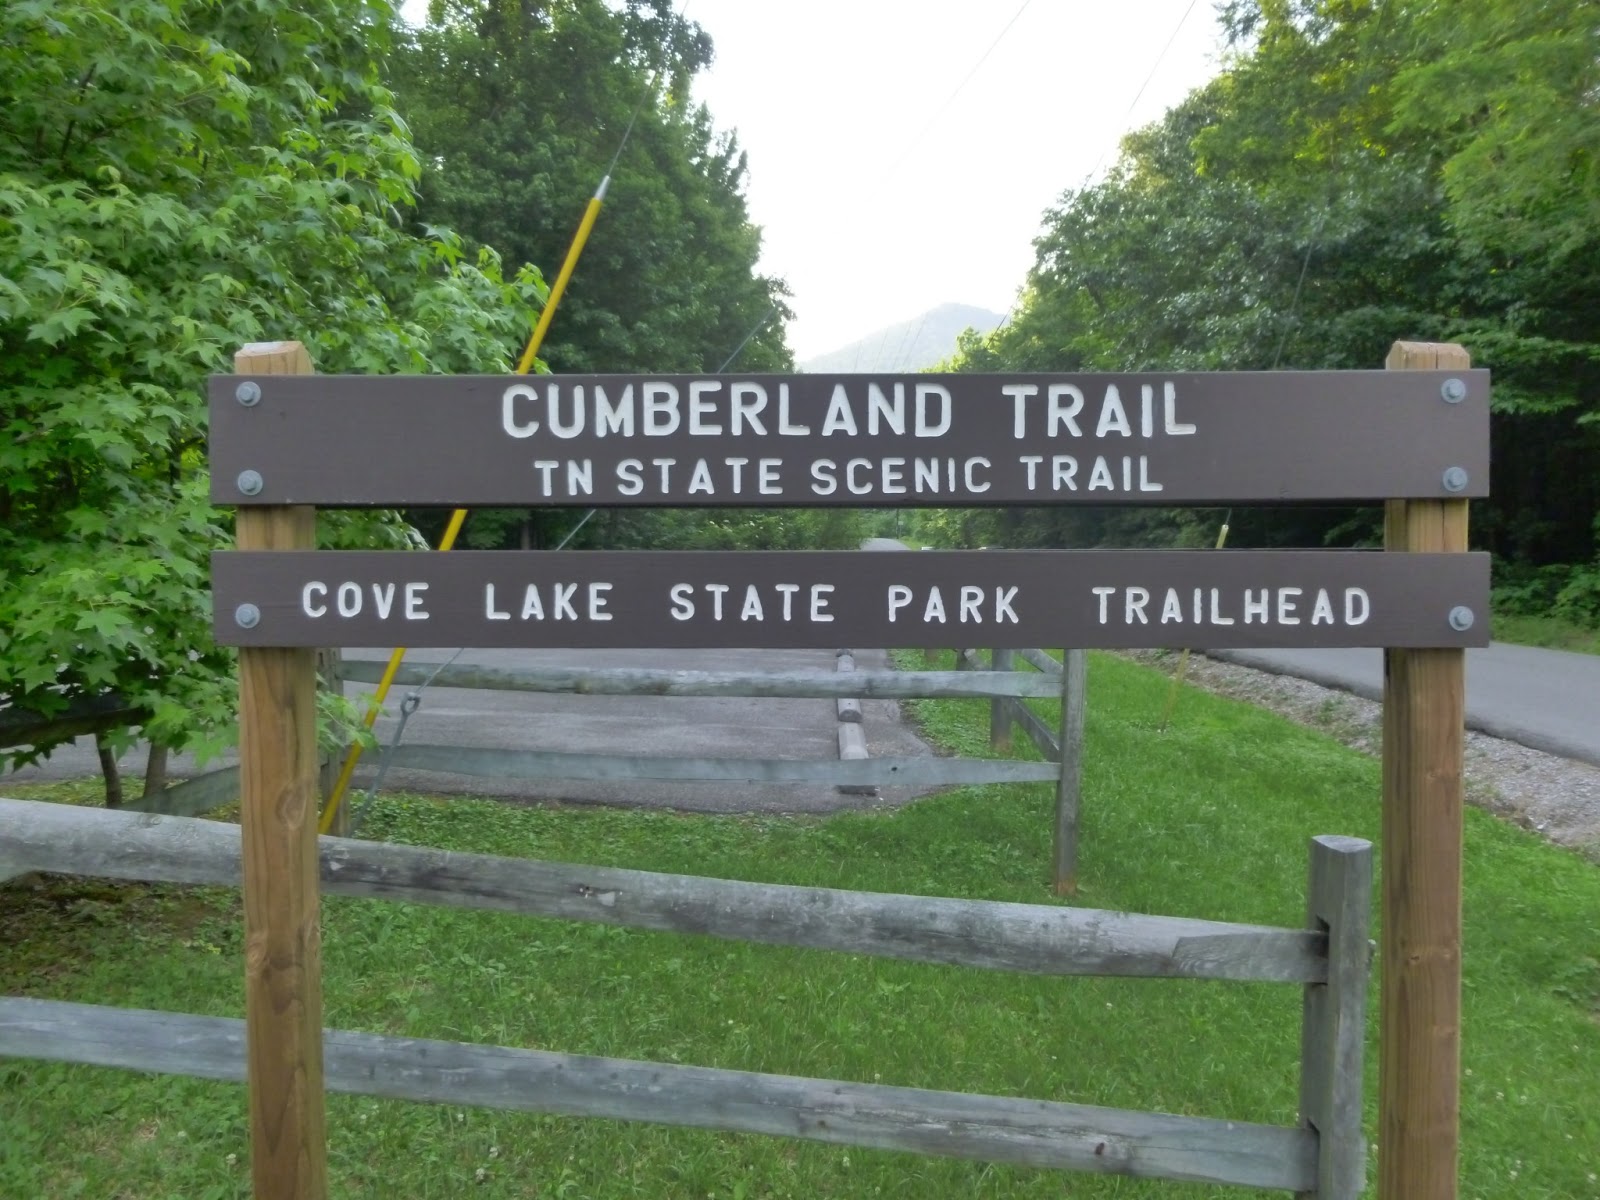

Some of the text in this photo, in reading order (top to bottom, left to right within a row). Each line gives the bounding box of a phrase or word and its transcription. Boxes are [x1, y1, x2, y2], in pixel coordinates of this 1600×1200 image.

[501, 380, 1197, 440] CUMBERLAND TRAIL
[533, 455, 1164, 497] TN STATE SCENIC TRAIL
[302, 581, 1371, 627] COVE LAKE STATE PARK TRAILHEAD
